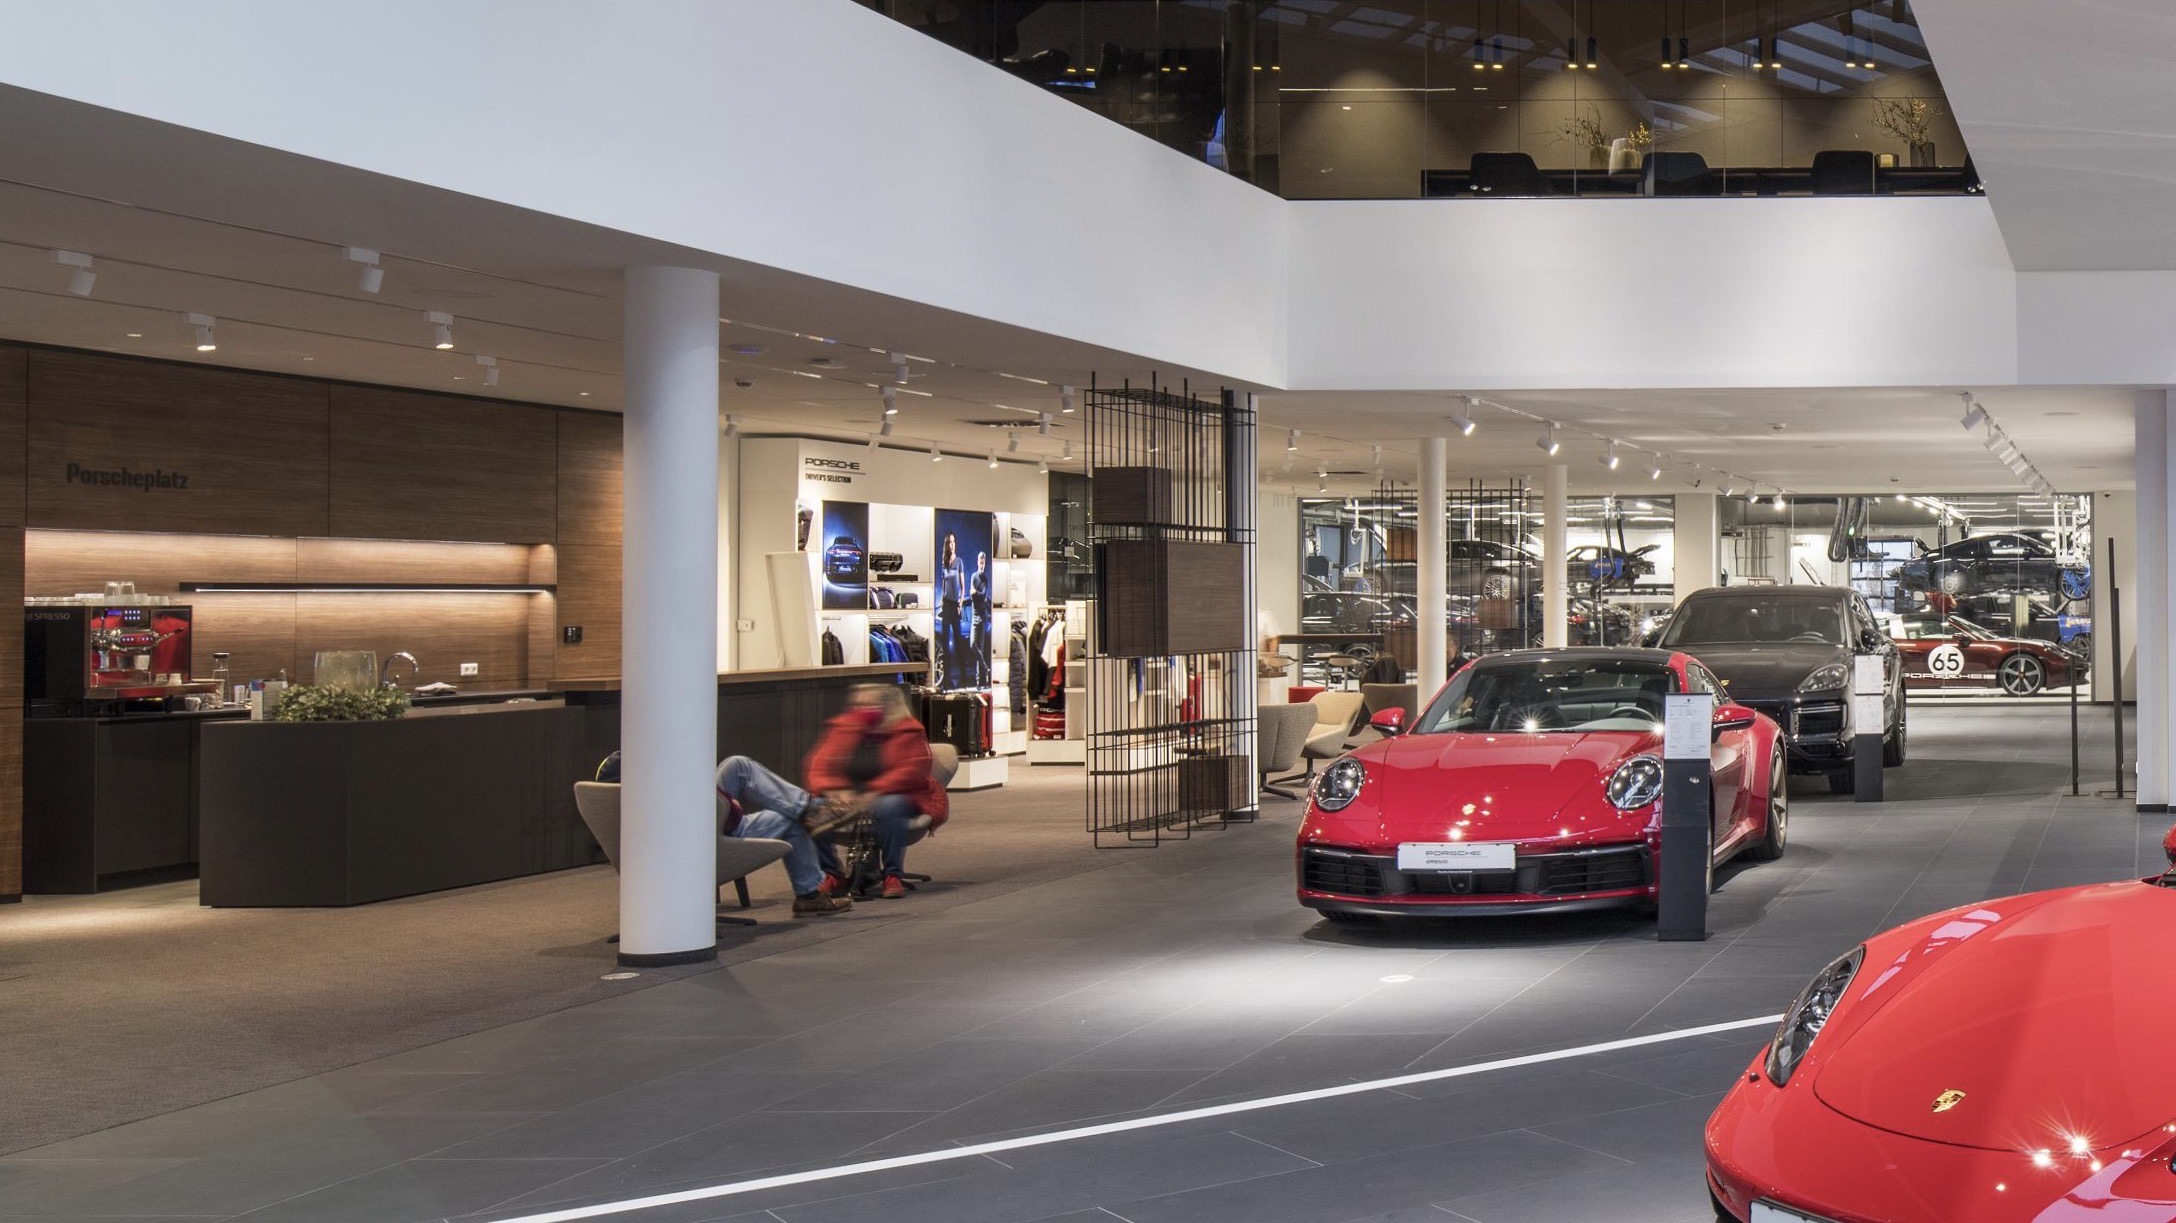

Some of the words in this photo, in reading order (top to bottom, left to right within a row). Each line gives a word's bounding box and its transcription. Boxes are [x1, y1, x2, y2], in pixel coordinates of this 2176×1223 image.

[805, 457, 860, 470] PORSCHE
[67, 463, 189, 492] Porscheplatz
[1933, 652, 1960, 672] 65
